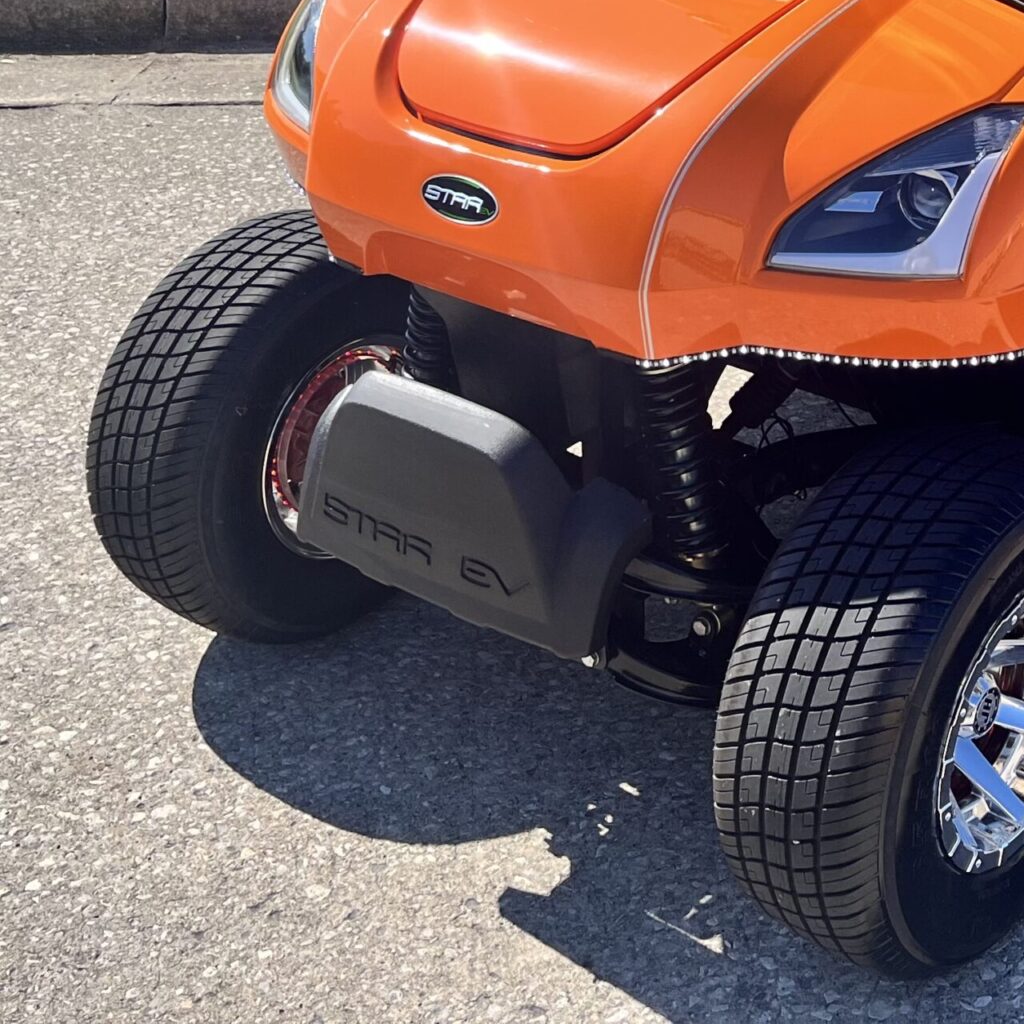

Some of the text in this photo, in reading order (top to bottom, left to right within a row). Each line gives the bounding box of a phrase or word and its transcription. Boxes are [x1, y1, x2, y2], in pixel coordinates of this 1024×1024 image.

[424, 184, 484, 214] STAR
[323, 492, 531, 597] STAR EV
